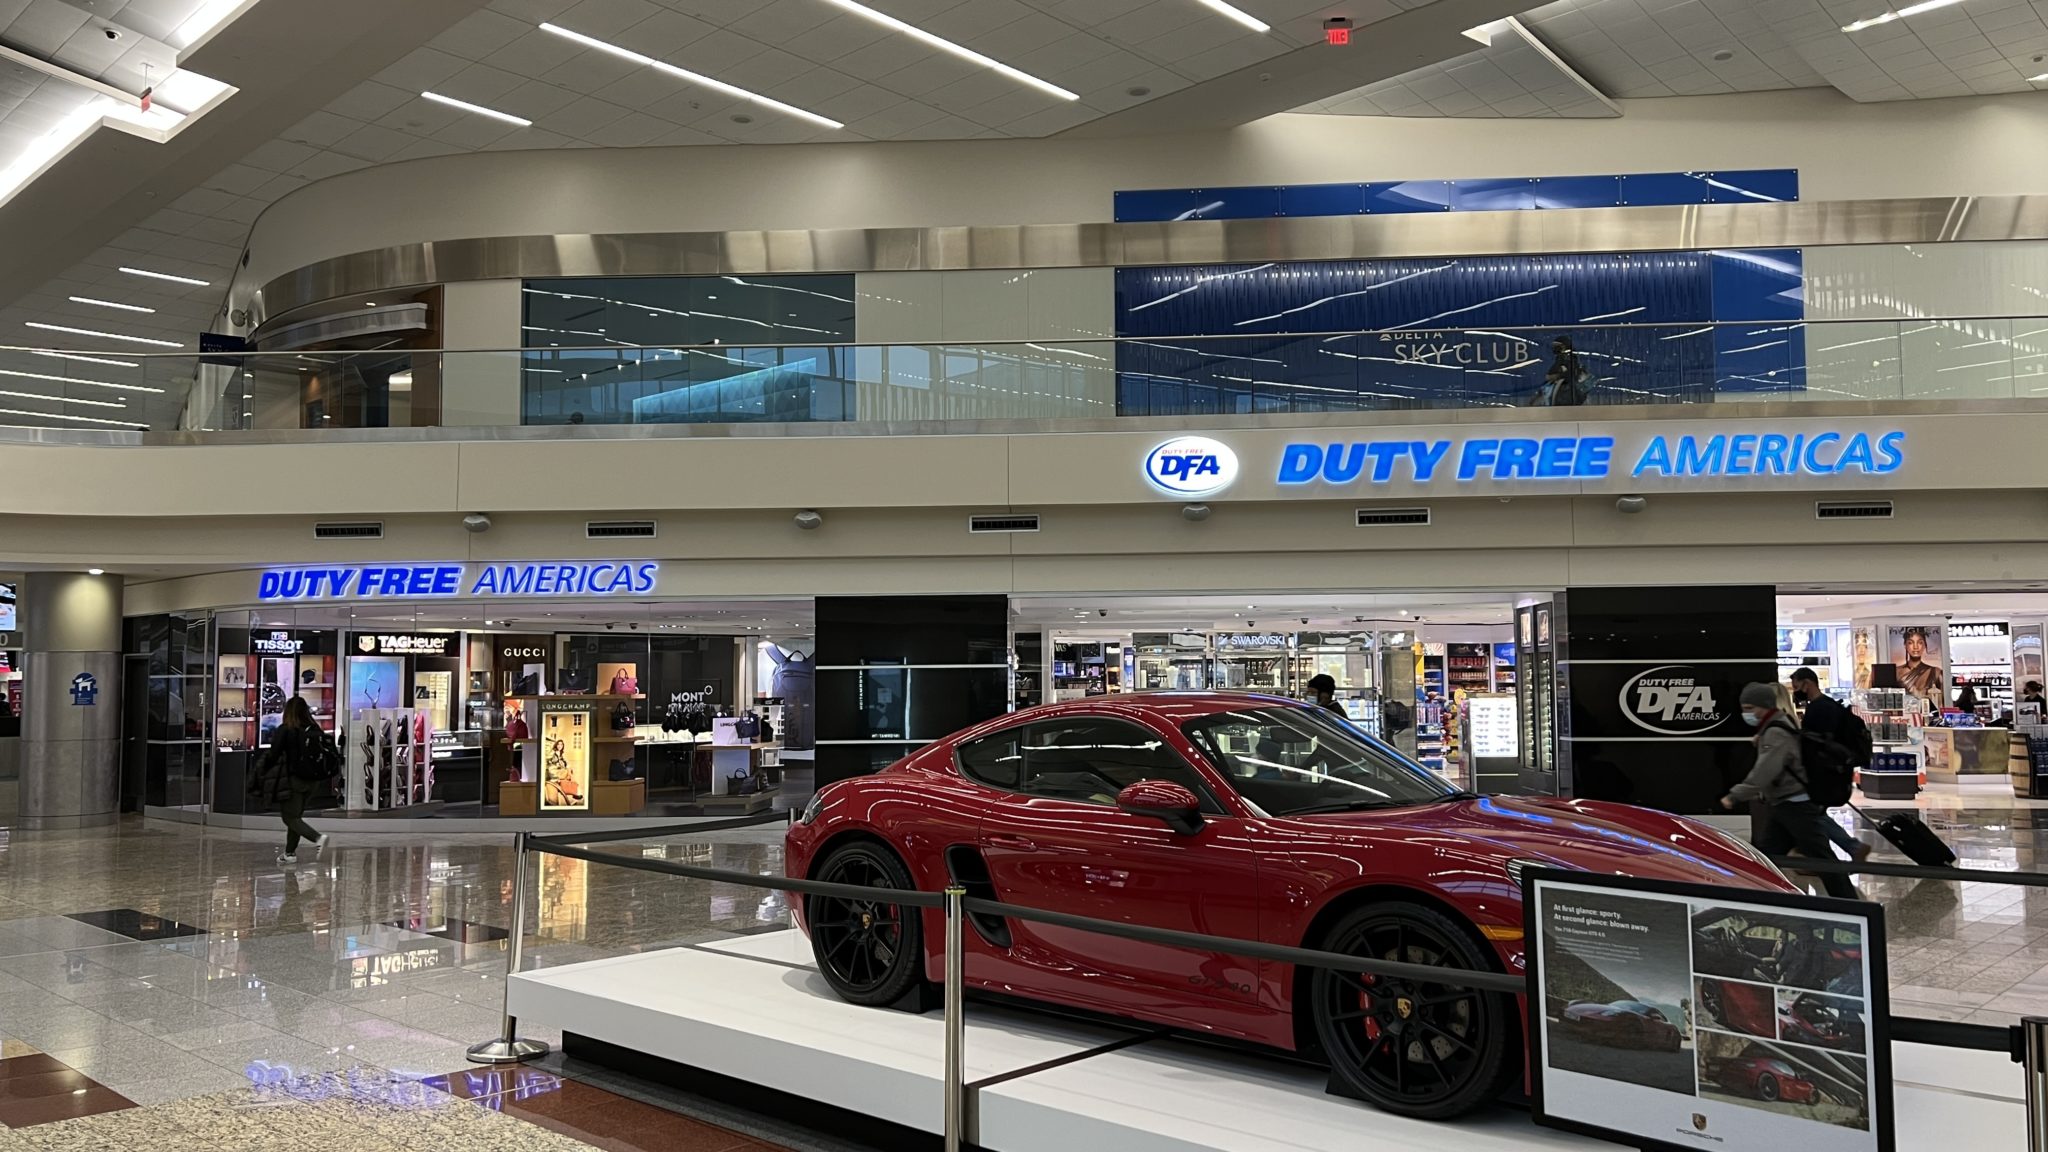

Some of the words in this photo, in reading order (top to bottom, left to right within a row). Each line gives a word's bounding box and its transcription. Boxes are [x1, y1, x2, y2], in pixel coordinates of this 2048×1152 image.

[1394, 343, 1447, 365] SKY
[1455, 341, 1529, 364] CLUB
[1277, 440, 1452, 484] DUTY
[1456, 436, 1614, 480] FREE
[1631, 431, 1905, 477] AMERICAS
[1160, 454, 1221, 482] DFA
[259, 568, 354, 599] DUTY
[357, 566, 463, 596] FREE
[471, 564, 657, 594] AMERICAS
[254, 640, 304, 650] TISSOT
[1231, 635, 1285, 645] SWAROVSKI
[503, 648, 545, 657] GUCCI
[1638, 678, 1669, 687] DUTY
[1668, 678, 1695, 686] FREE
[671, 691, 705, 703] MONT
[1636, 685, 1717, 721] DFA
[541, 702, 591, 710] LONGCHAMP
[1673, 711, 1720, 721] AMERICAS
[1562, 915, 1585, 923] second
[1609, 920, 1630, 930] blown
